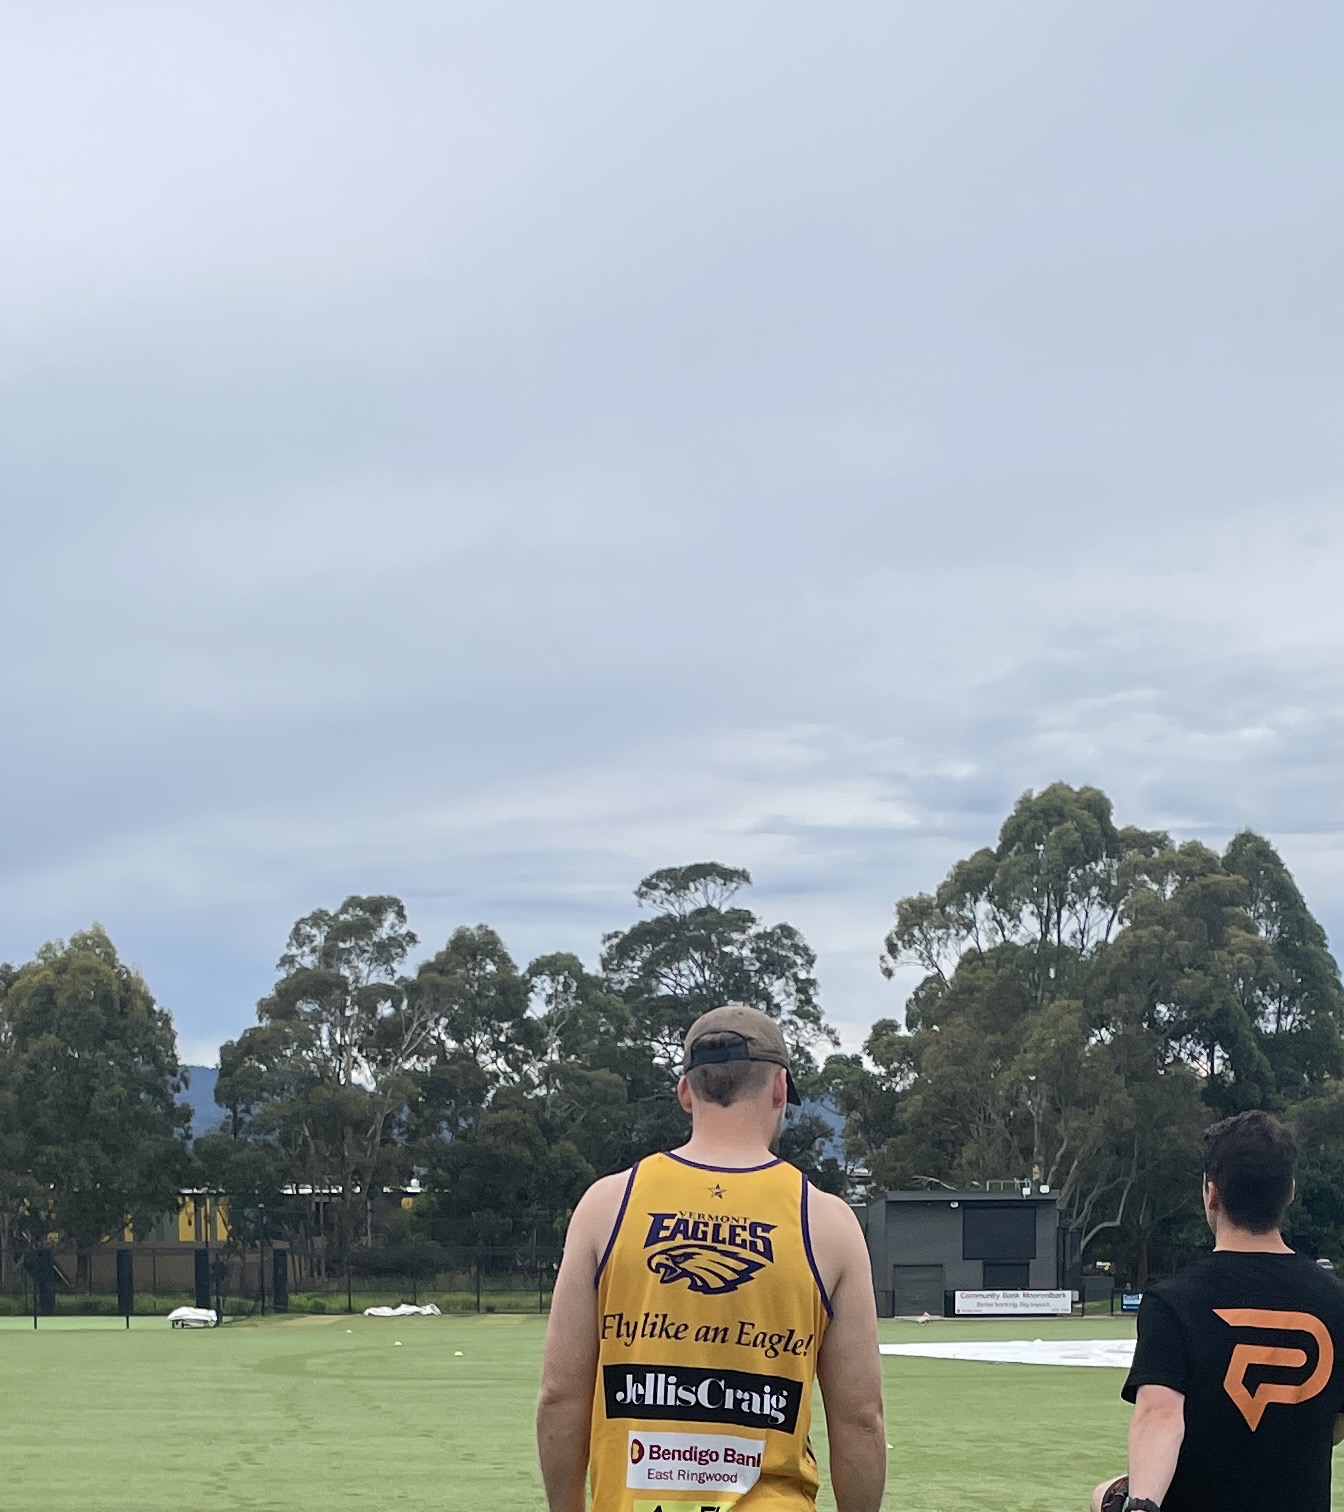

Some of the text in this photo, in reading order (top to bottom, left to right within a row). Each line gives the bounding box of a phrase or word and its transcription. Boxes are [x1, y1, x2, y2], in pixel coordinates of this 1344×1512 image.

[679, 1210, 750, 1224] VERMONT
[643, 1212, 778, 1263] EAGLES
[960, 1291, 1000, 1300] Community
[1002, 1291, 1020, 1299] Bank
[601, 1312, 814, 1358] Fly like an Eagle!
[648, 1444, 720, 1466] Bendigo
[647, 1468, 738, 1484] East Ringwood
